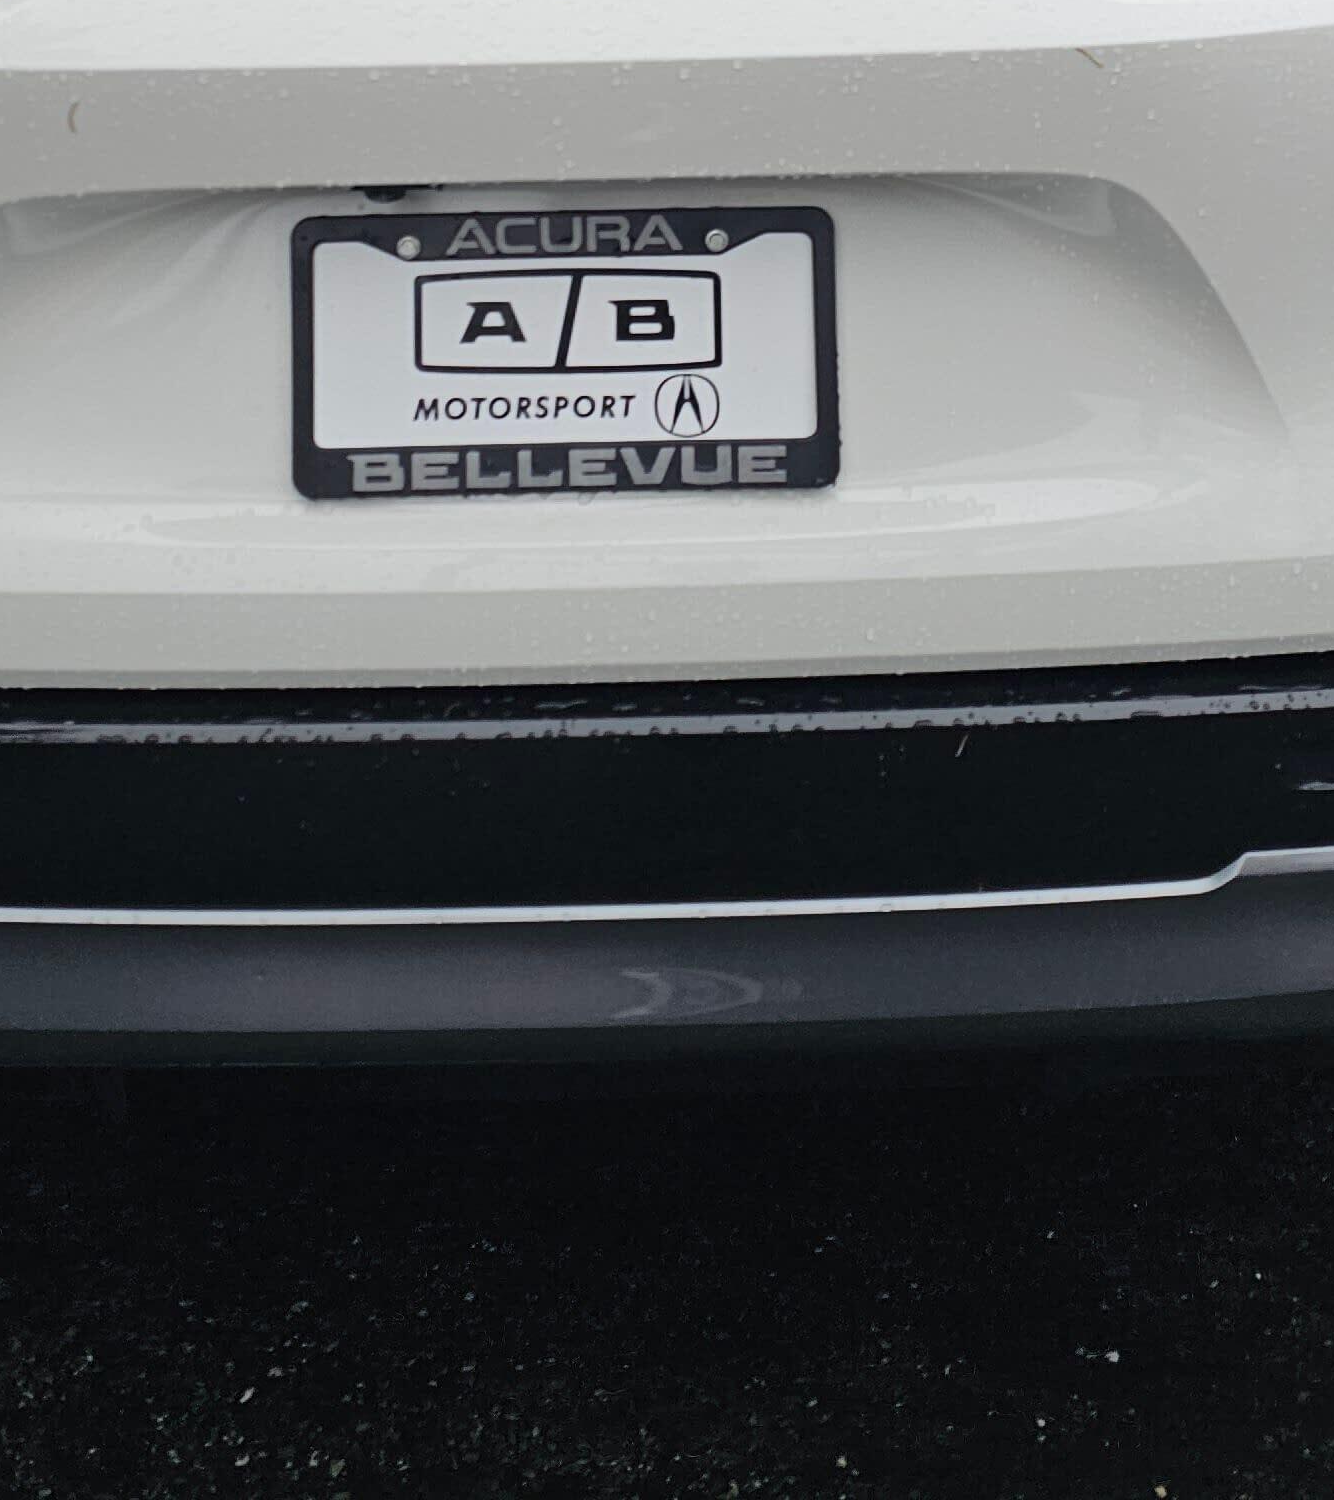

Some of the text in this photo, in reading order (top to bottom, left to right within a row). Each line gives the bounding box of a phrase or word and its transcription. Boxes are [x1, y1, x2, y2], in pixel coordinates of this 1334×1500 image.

[446, 214, 683, 256] ACURA
[413, 395, 636, 422] MOTORSPORT
[347, 444, 788, 493] BELLEVUE
